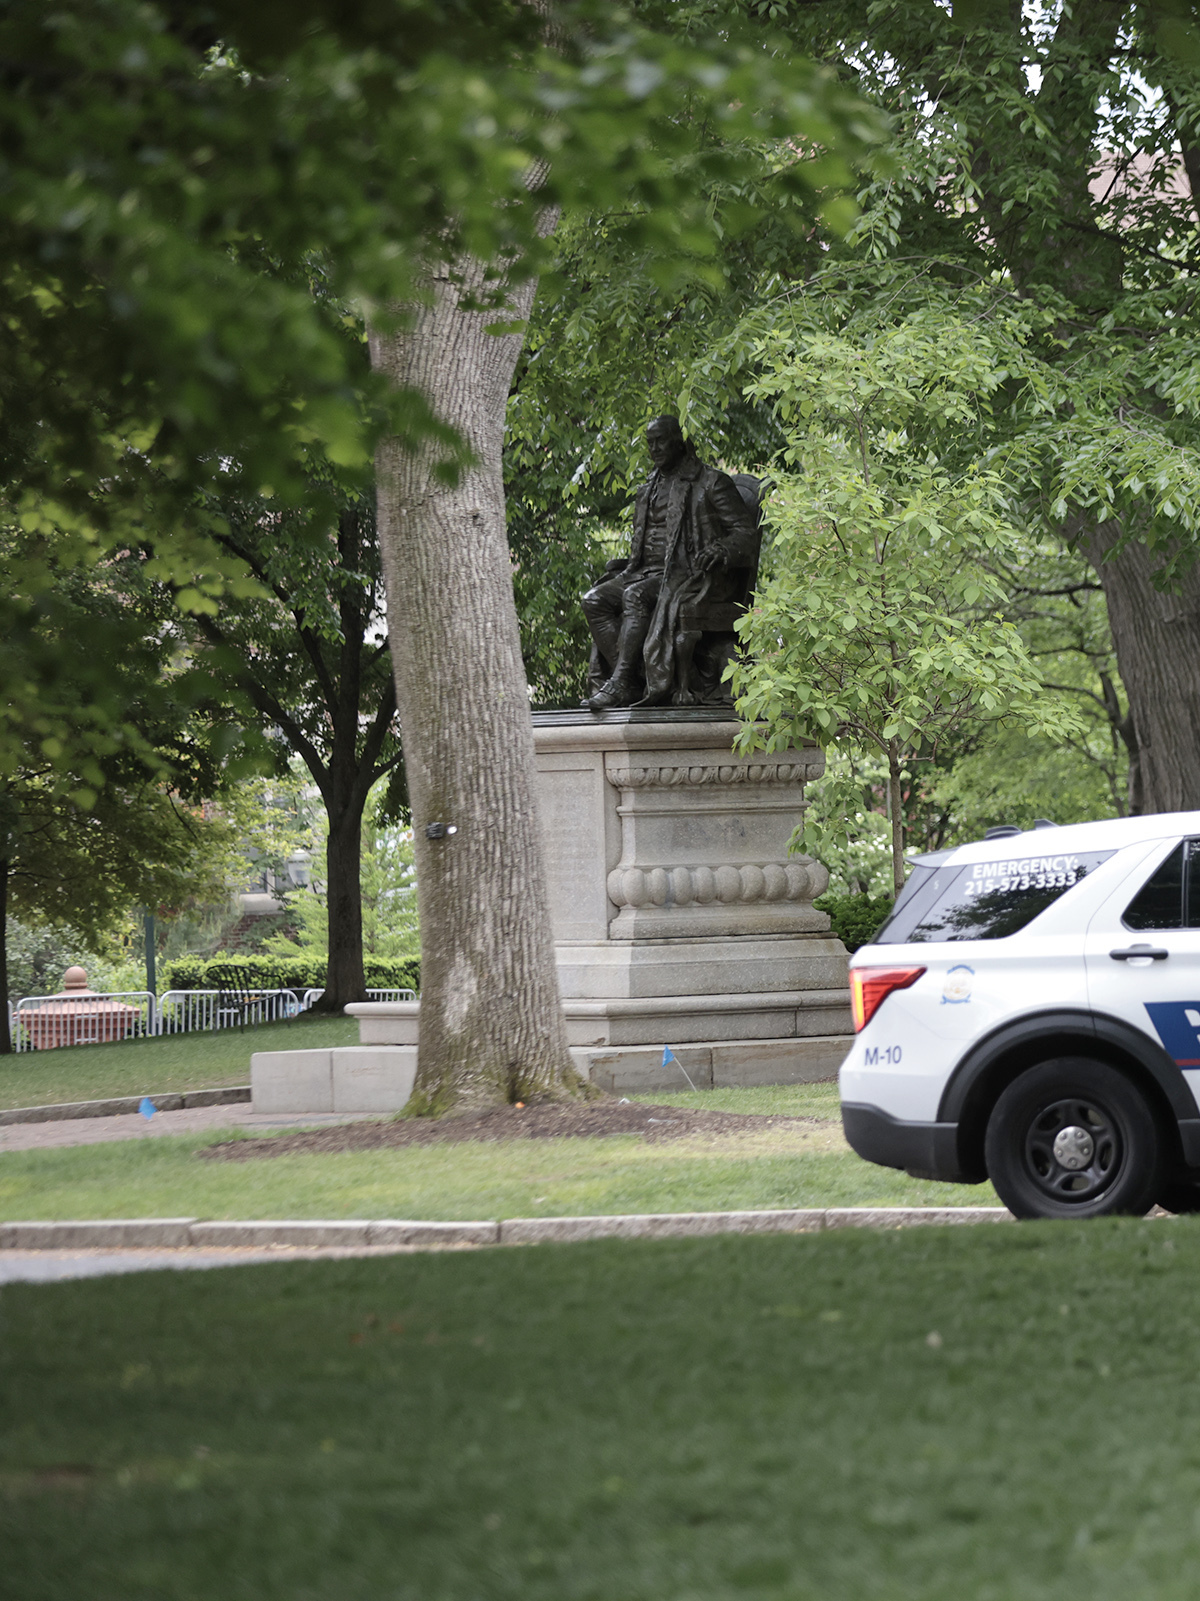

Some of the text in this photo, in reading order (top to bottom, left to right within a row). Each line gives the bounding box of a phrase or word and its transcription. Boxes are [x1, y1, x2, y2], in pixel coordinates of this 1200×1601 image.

[972, 855, 1079, 879] EMERGENCY:
[964, 871, 1077, 896] 215-573-3333
[864, 1045, 902, 1067] M-10
